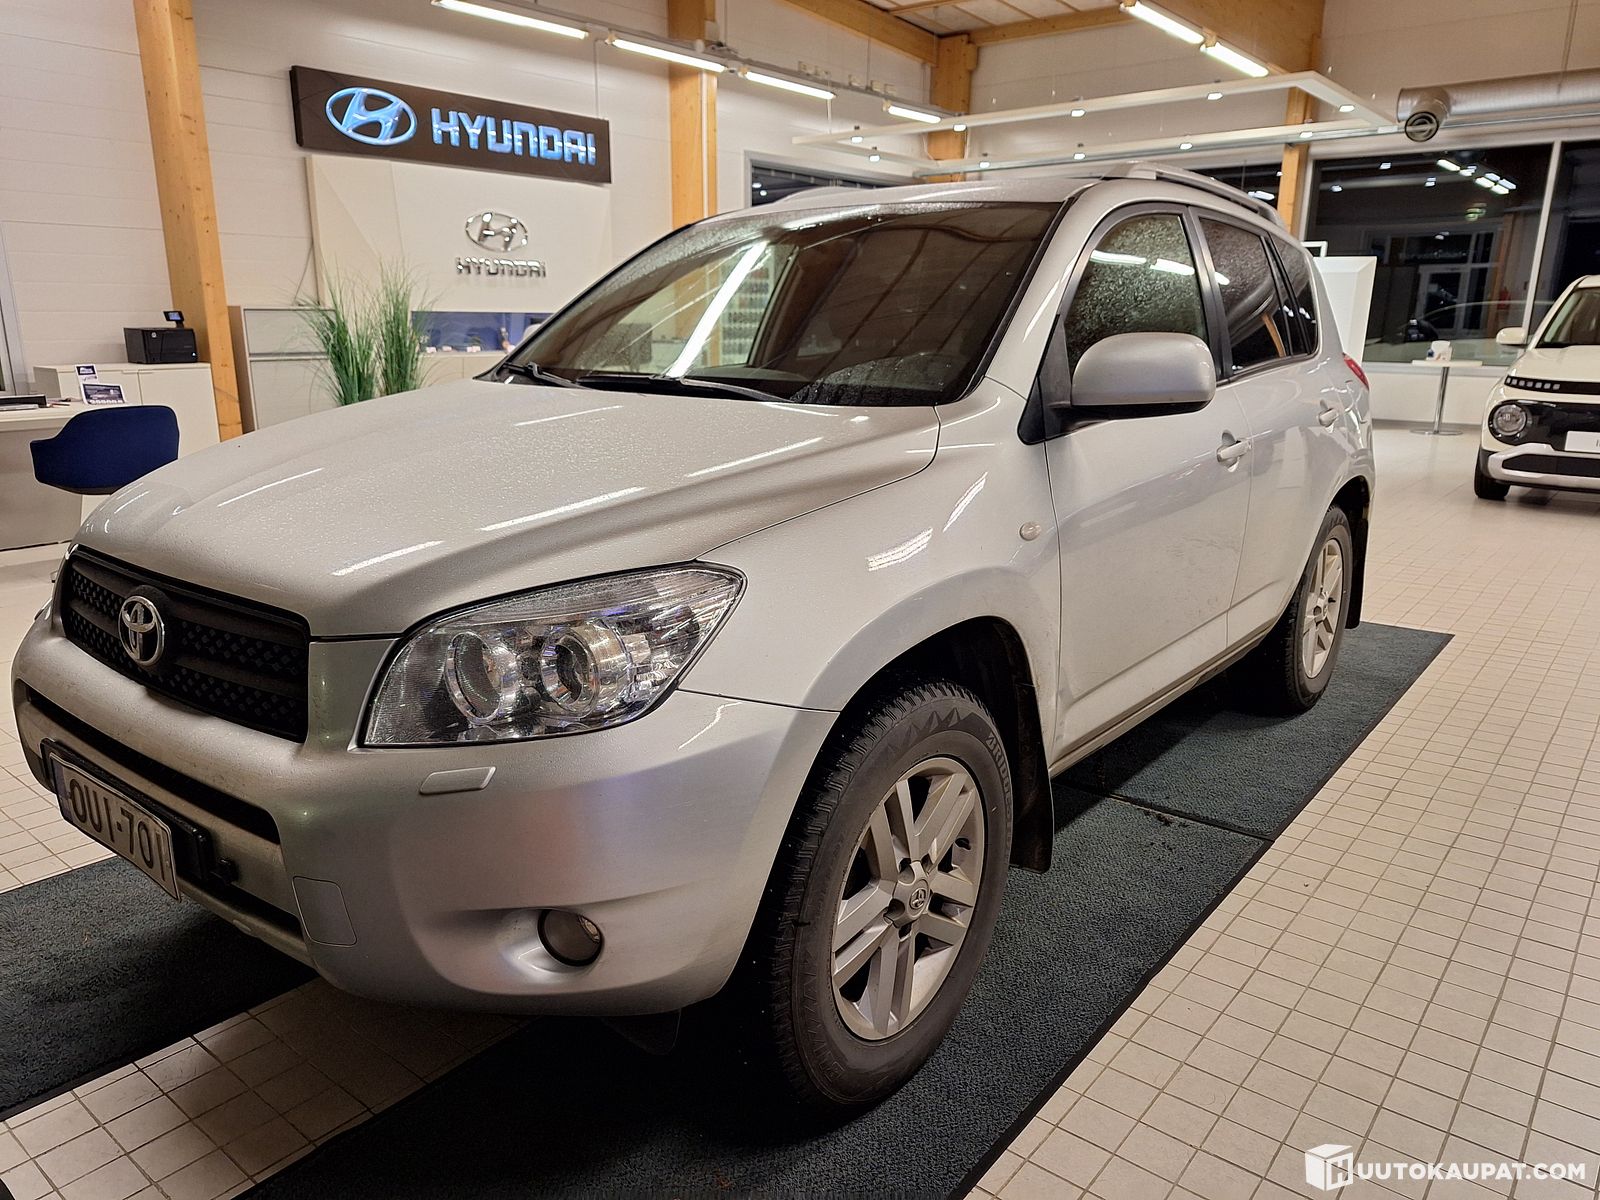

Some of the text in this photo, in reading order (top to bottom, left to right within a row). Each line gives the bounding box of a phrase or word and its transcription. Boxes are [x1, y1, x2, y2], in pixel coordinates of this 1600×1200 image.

[430, 107, 596, 165] HYUNDAI
[455, 257, 546, 278] HYUNDAI
[69, 778, 166, 882] OUI-701
